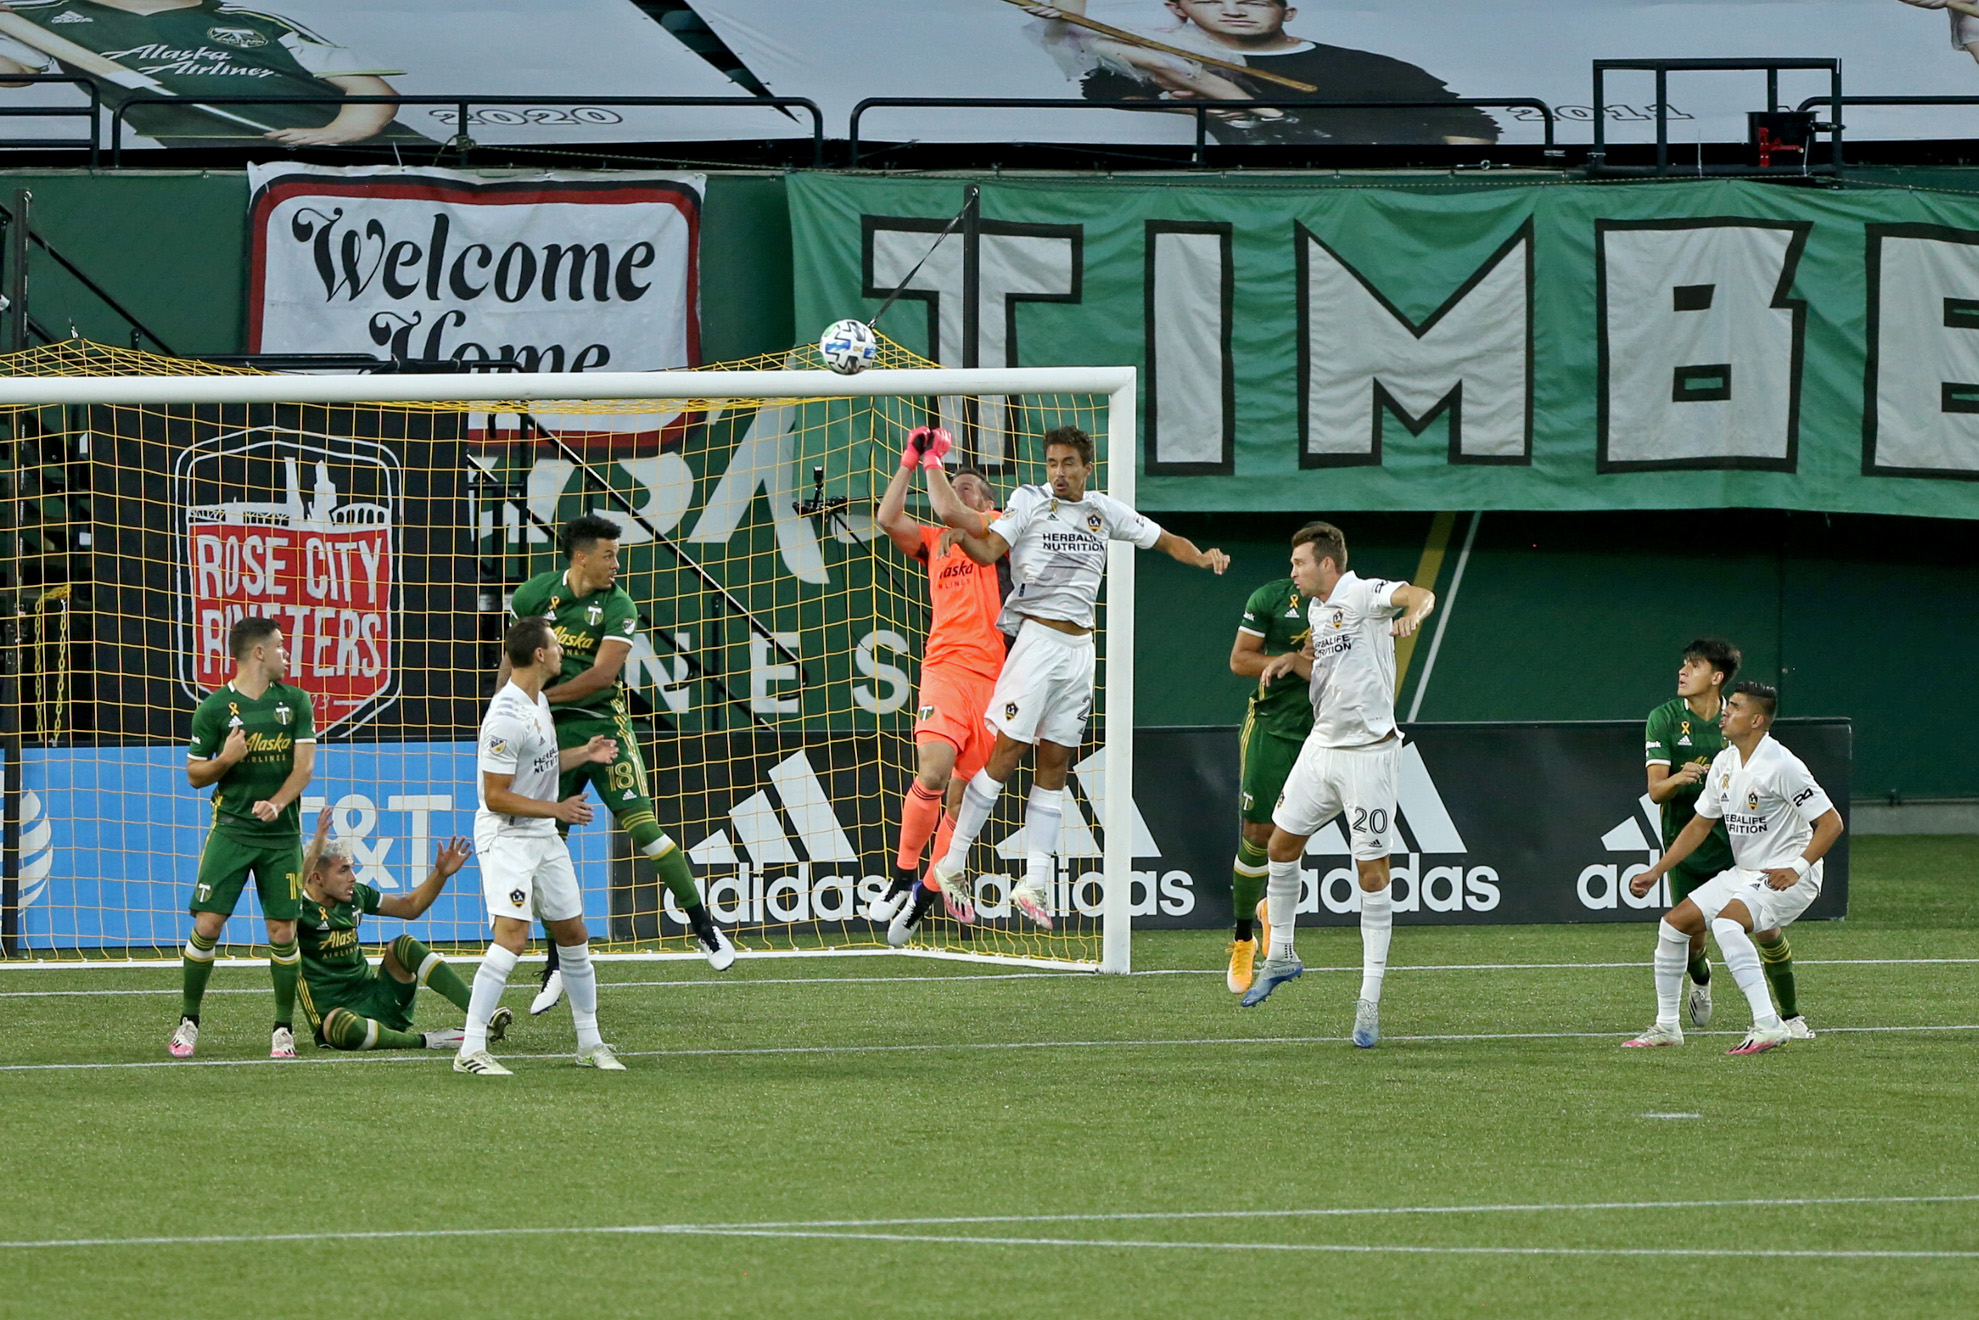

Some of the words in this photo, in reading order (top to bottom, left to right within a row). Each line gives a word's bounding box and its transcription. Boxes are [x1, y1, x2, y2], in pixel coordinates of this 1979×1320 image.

[99, 43, 234, 62] Alaska
[137, 62, 275, 78] Airlines
[428, 107, 623, 126] 2020
[291, 206, 657, 303] Welcome
[196, 534, 289, 600] ROSE
[306, 537, 382, 604] CITY
[202, 602, 382, 678] RITERS
[605, 761, 635, 792] 18
[1352, 806, 1388, 834] 20
[973, 856, 1196, 919] aidas
[1295, 853, 1501, 915] addas
